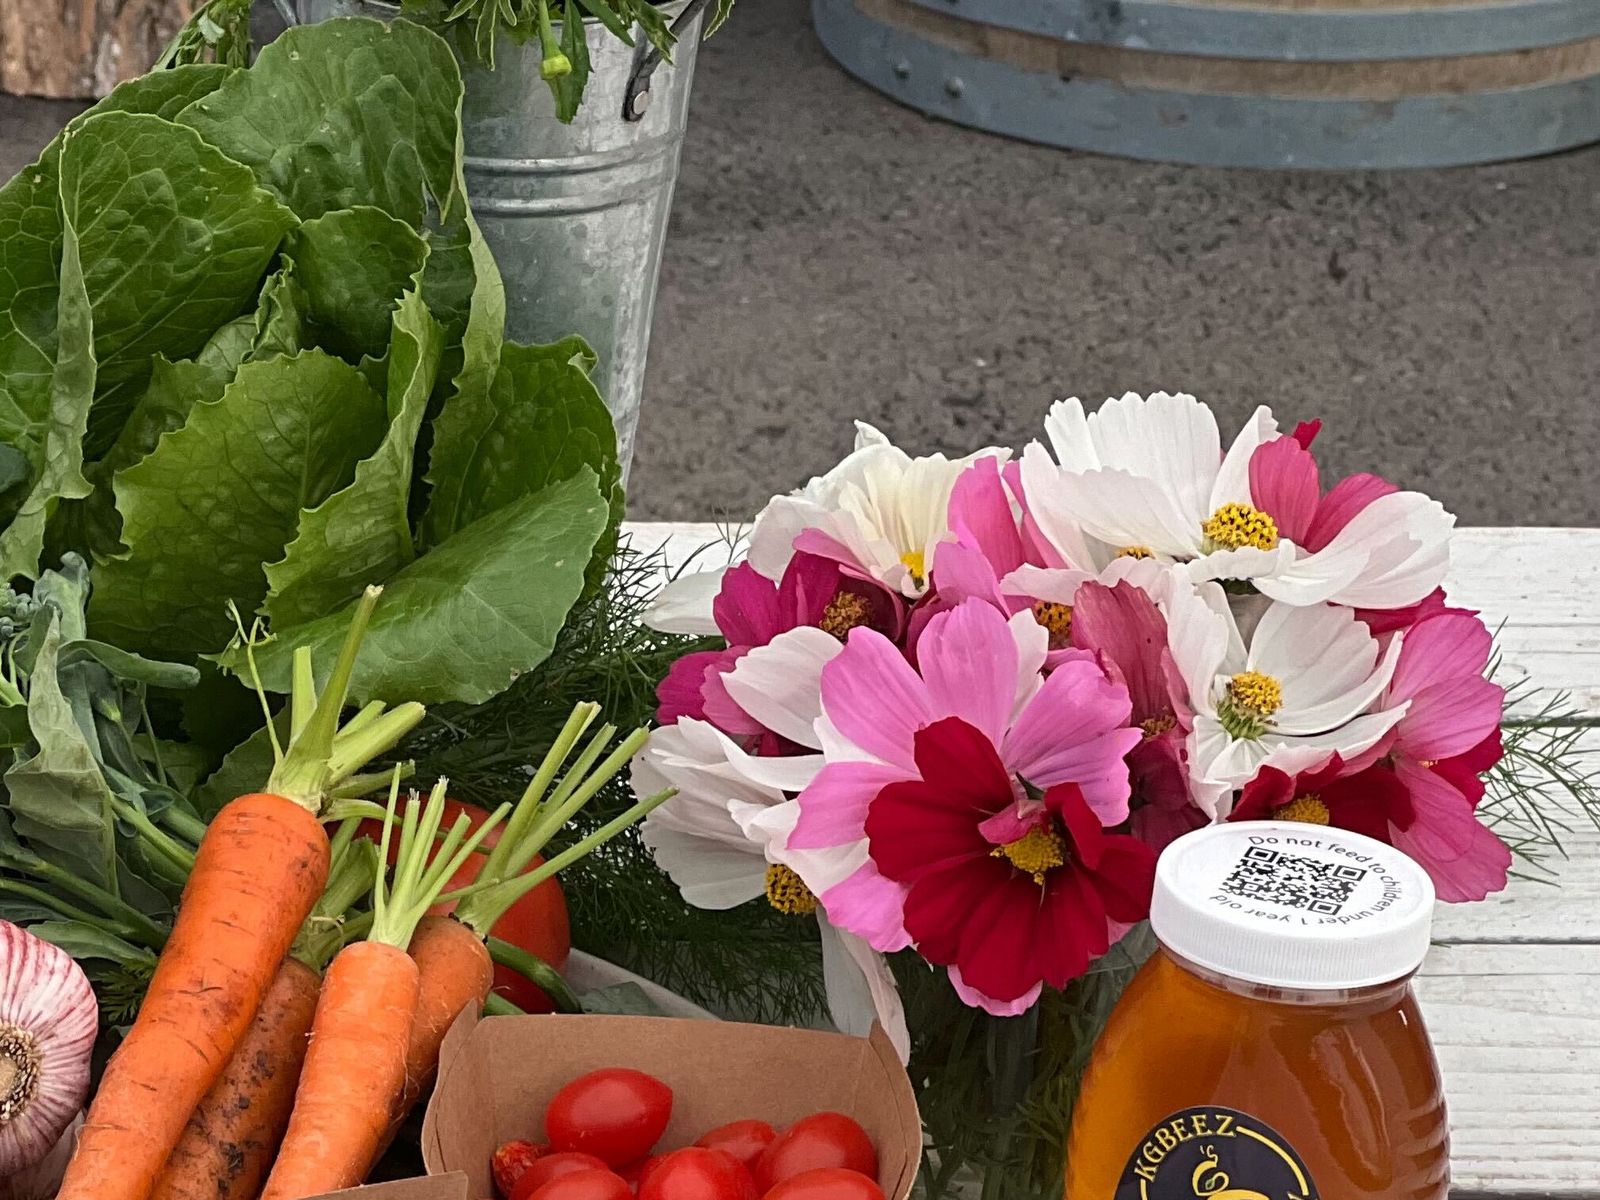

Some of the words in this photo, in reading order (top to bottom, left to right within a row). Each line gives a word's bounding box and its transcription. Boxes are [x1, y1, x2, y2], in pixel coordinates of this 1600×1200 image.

[1248, 835, 1279, 846] Do
[1286, 836, 1324, 849] not
[1327, 843, 1374, 863] feed
[1367, 863, 1386, 874] to
[1370, 876, 1403, 912] children
[1208, 894, 1243, 910] old
[1244, 908, 1291, 924] year
[1300, 917, 1309, 926] 1
[1319, 910, 1375, 925] under
[1134, 1114, 1237, 1183] KGBEEZ
